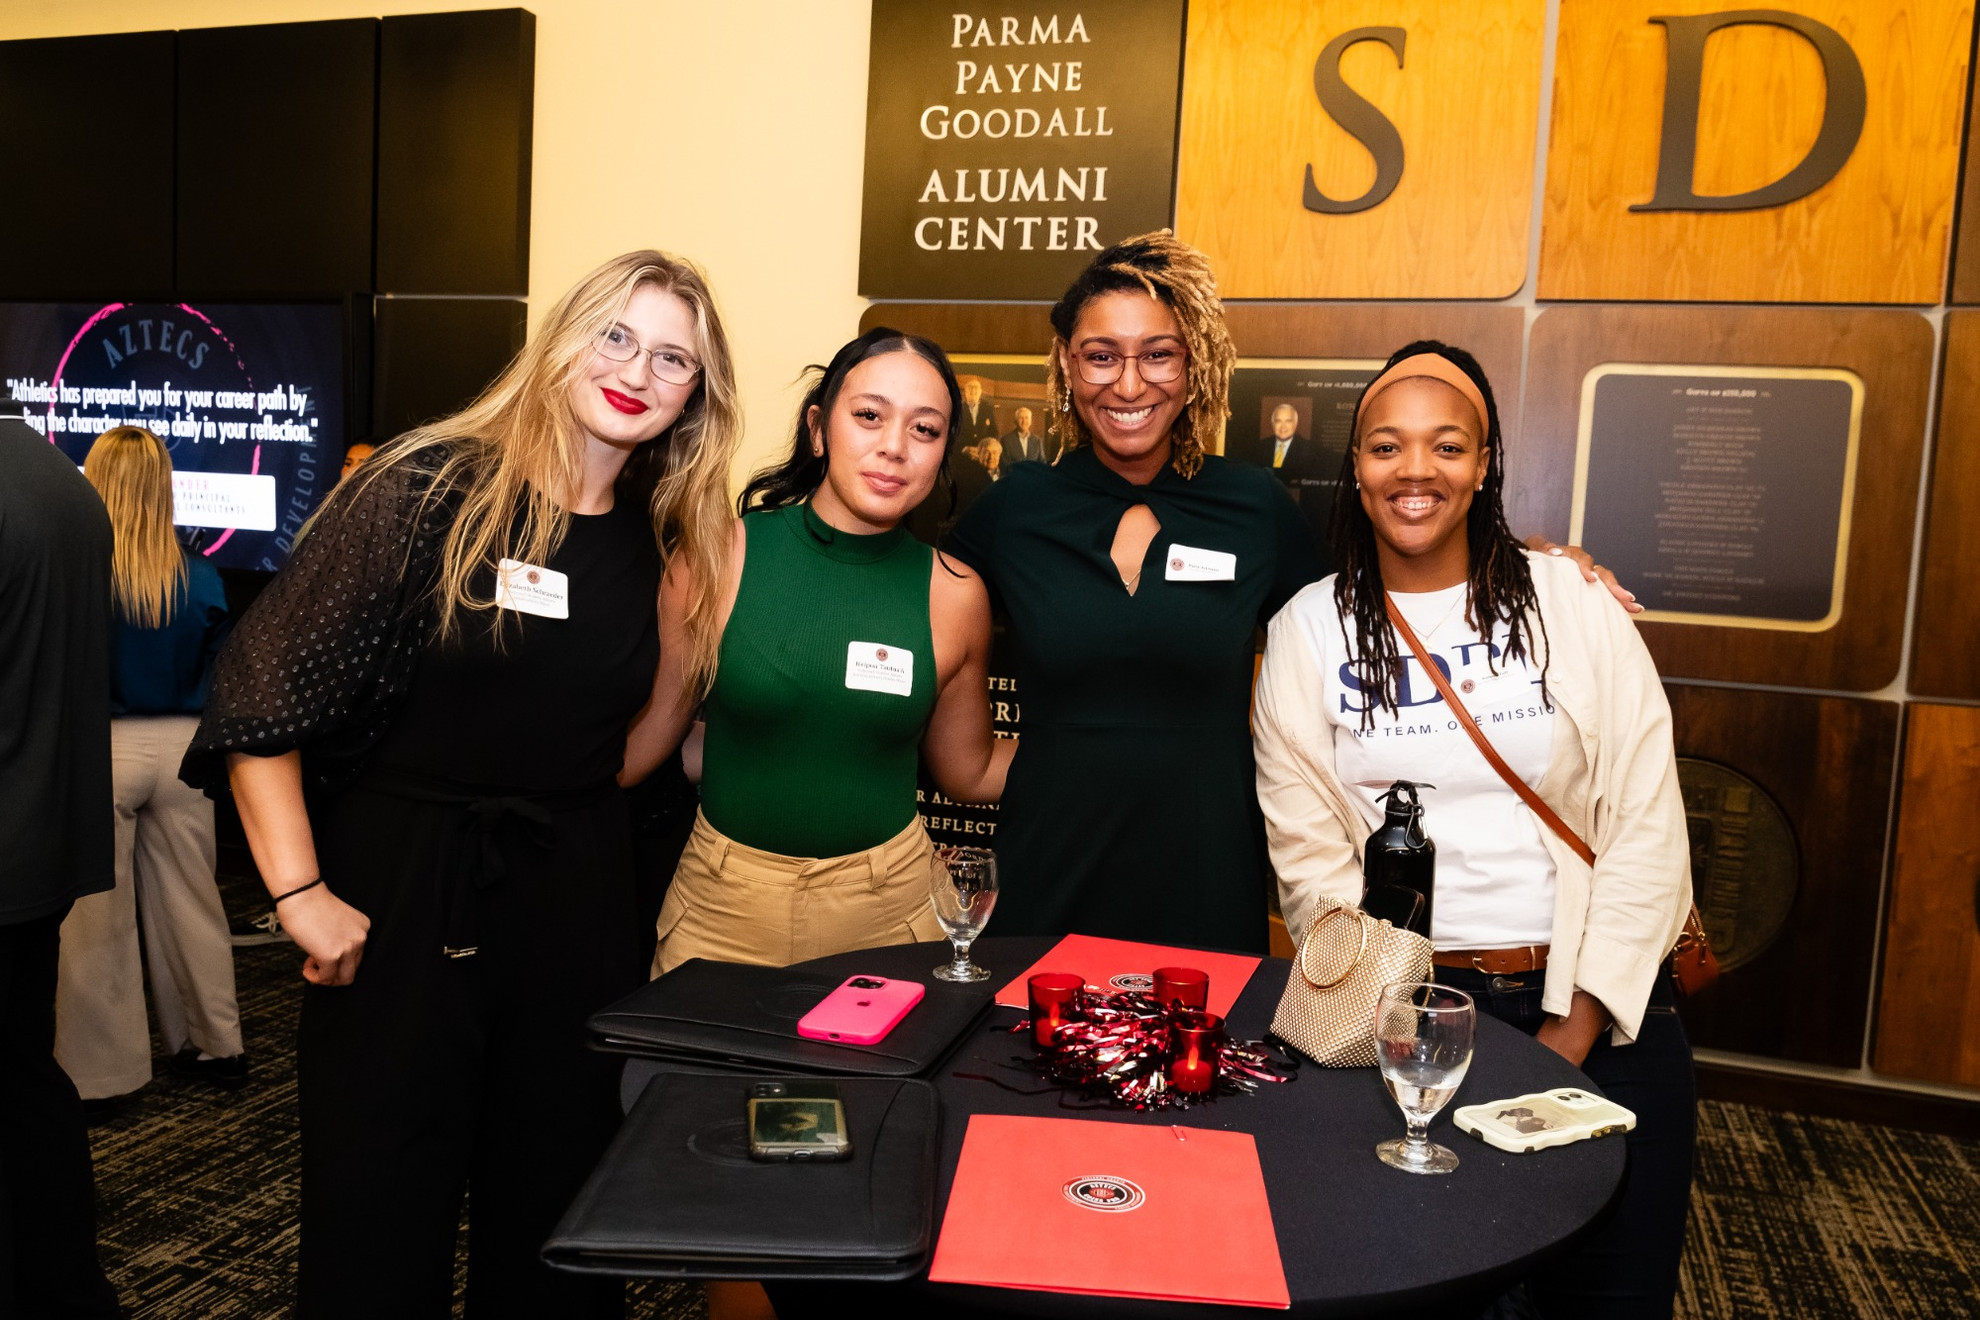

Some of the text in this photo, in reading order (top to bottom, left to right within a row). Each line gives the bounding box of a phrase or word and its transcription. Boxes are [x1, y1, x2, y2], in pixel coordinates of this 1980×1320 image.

[952, 14, 1090, 47] PARMA
[956, 61, 1082, 94] PAYNE
[920, 106, 1113, 139] GOODALL
[1302, 9, 1867, 214] S D
[918, 167, 1108, 202] ALUMNI
[914, 217, 1104, 250] CENTER
[101, 319, 210, 369] AZTECS
[7, 377, 307, 416] "Athletics has prepared you for your career path by
[46, 407, 66, 432] the
[148, 418, 169, 436] see
[172, 412, 202, 443] daily
[203, 416, 216, 438] in
[218, 421, 248, 445] your
[1353, 728, 1374, 738] NE
[1384, 724, 1438, 737] TEAM.
[1447, 715, 1483, 731] OE
